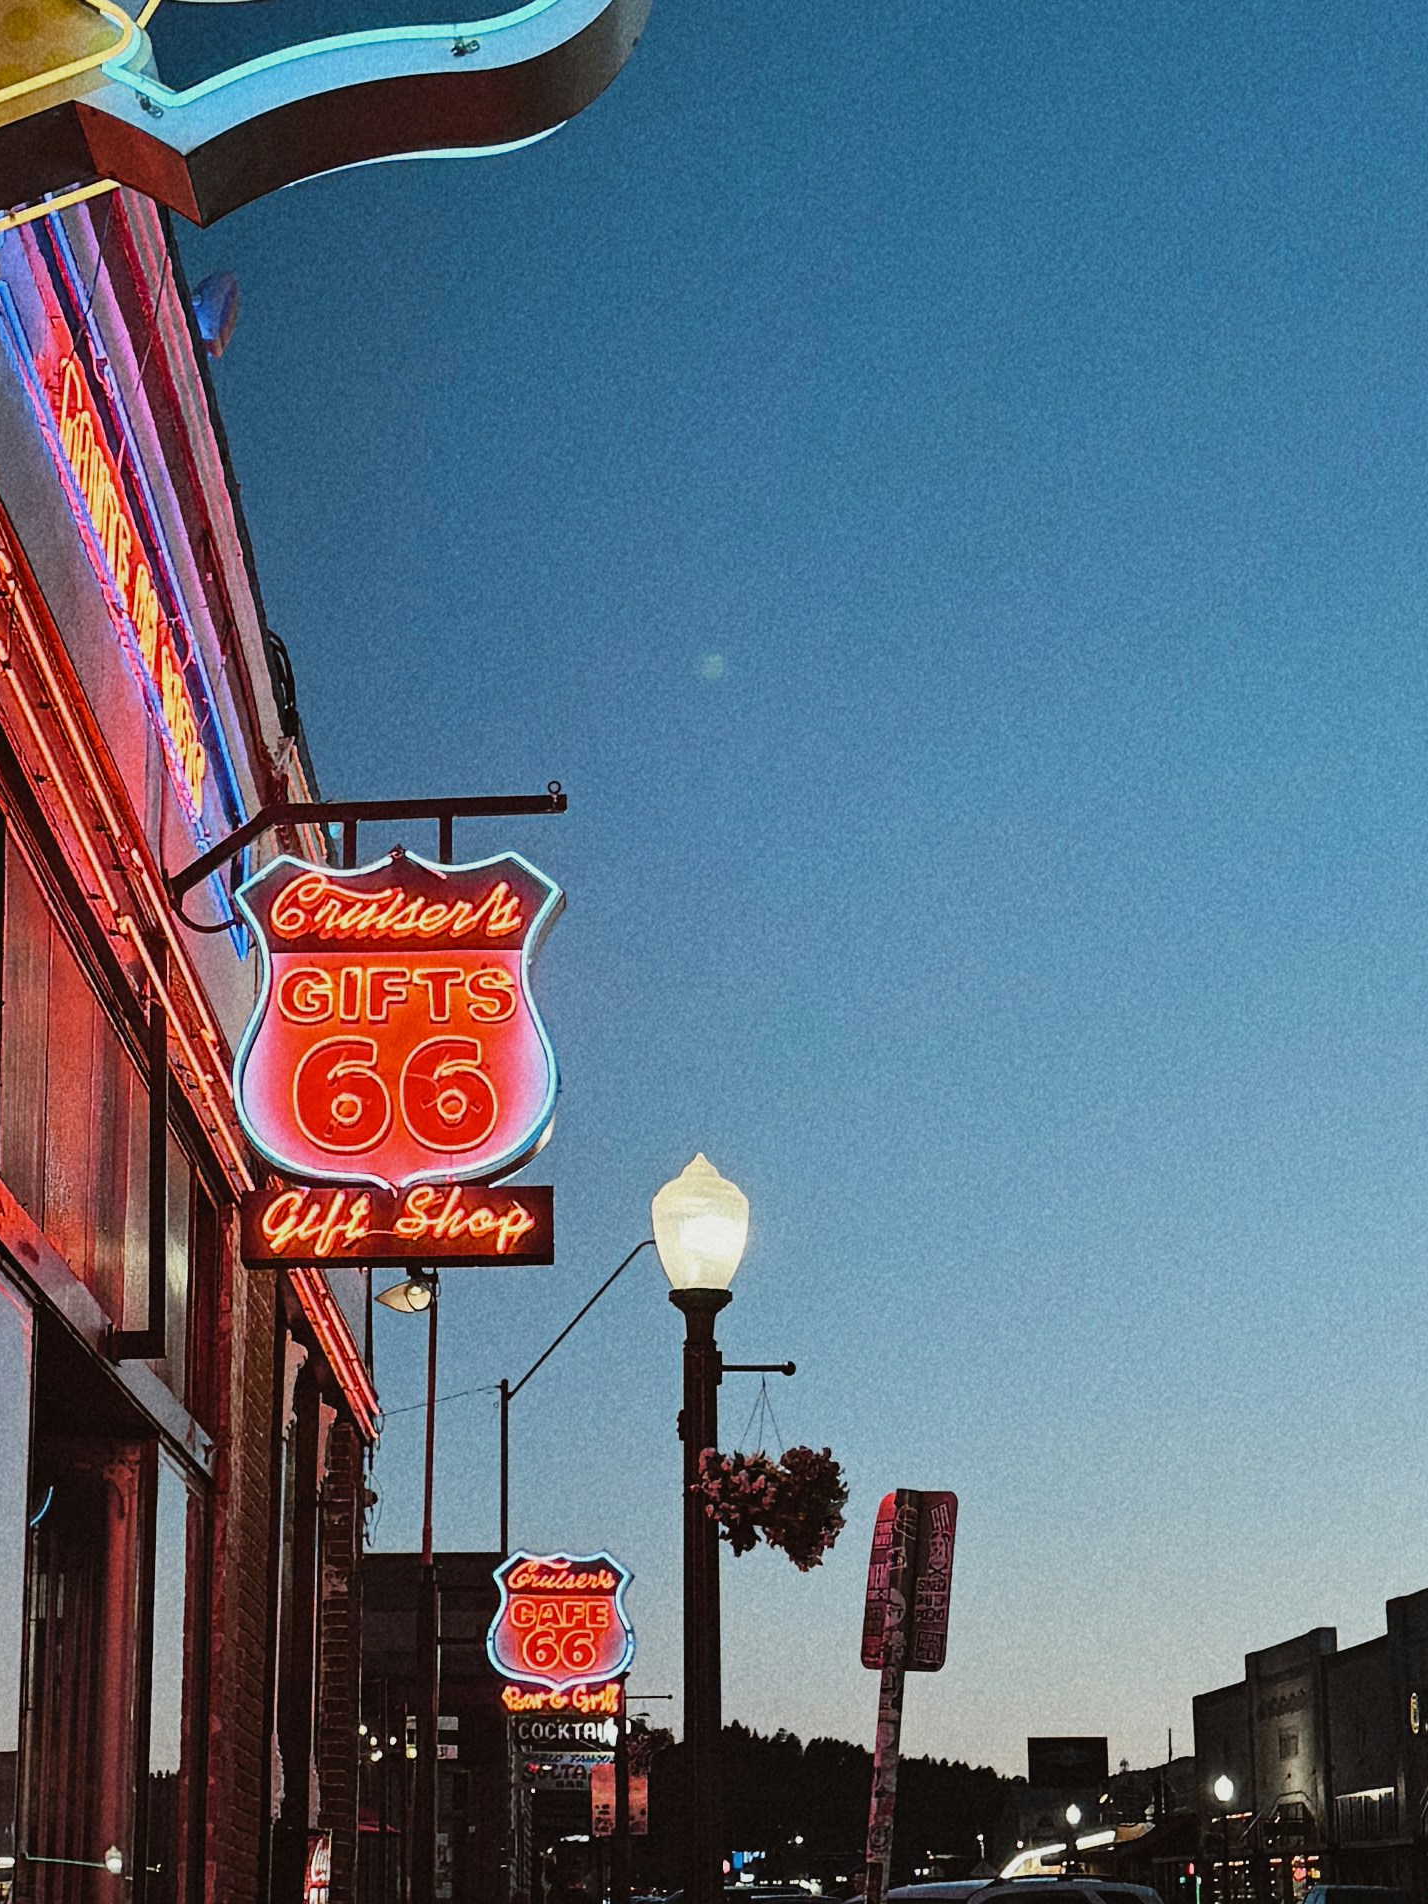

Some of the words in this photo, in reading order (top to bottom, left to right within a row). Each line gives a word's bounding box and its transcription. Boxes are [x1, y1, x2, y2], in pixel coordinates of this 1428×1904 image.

[269, 872, 523, 938] Cruiser's
[275, 965, 517, 1024] GIFTS
[292, 1035, 498, 1153] 66
[260, 1192, 372, 1256] Gift
[394, 1186, 535, 1254] Shop
[509, 1600, 610, 1630] CAFE
[522, 1629, 598, 1672] 66
[501, 1686, 547, 1712] Bar
[572, 1683, 620, 1714] Grill
[556, 1780, 584, 1789] BAR
